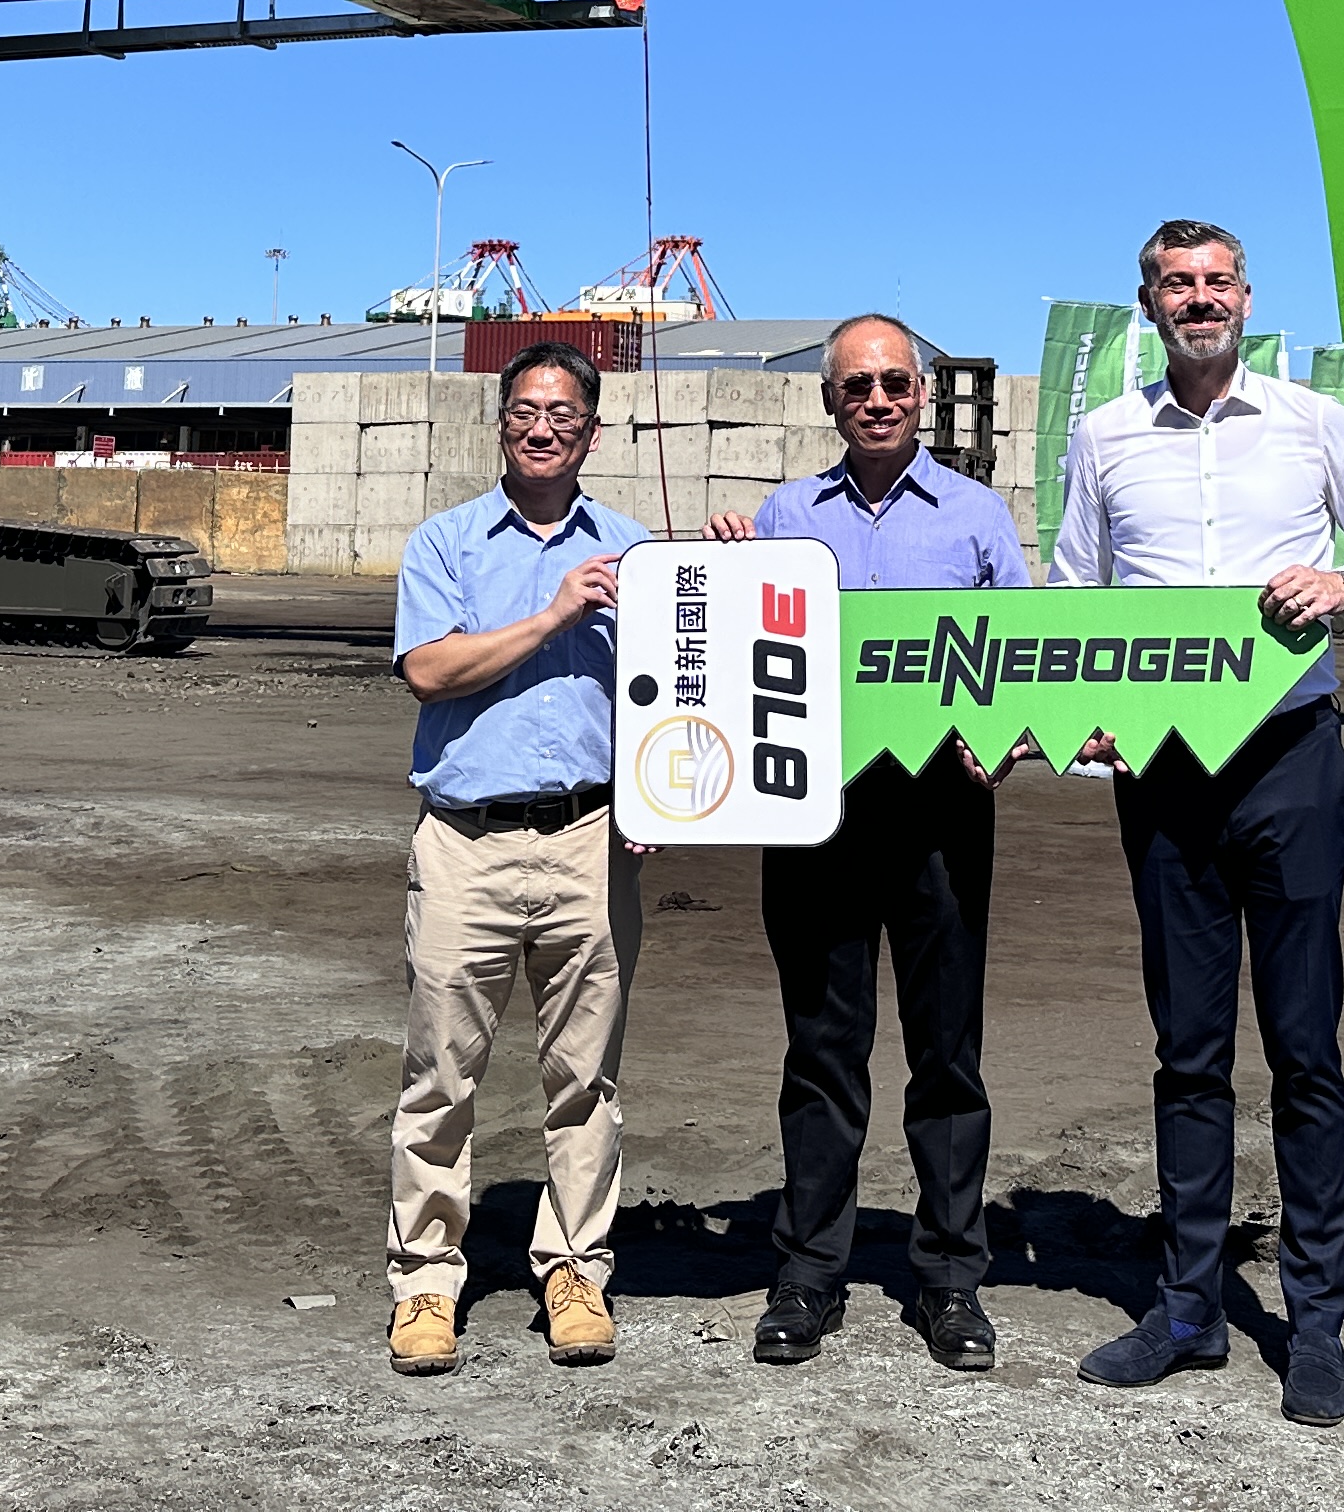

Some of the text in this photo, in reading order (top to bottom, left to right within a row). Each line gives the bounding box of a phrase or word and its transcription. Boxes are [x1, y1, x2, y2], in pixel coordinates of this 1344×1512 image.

[674, 564, 708, 708] 建新國際
[752, 582, 808, 801] 870E
[856, 614, 1256, 708] SENNEBOGEN
